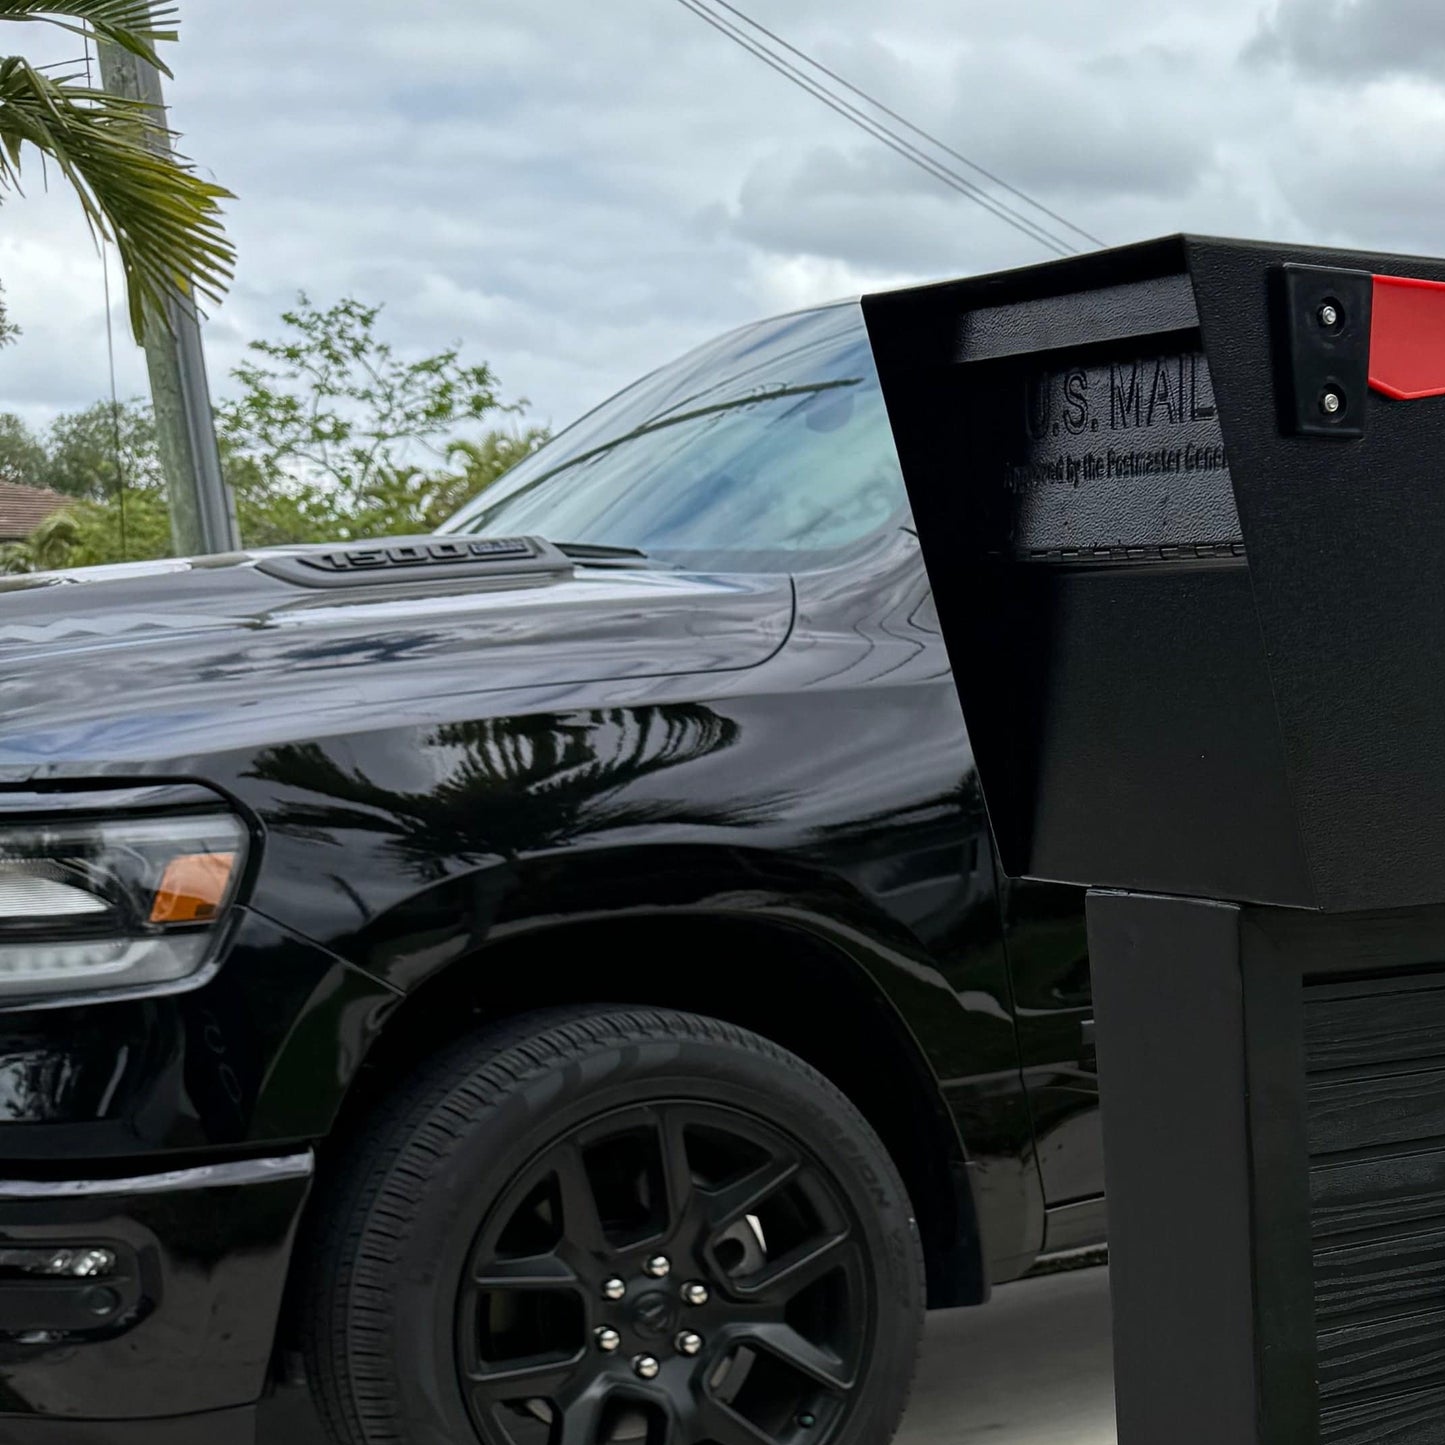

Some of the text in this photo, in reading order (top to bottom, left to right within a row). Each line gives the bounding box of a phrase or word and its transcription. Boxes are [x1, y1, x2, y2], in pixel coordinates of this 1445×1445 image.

[1026, 352, 1218, 440] U.S. MAIL
[1066, 453, 1081, 489] by
[1083, 451, 1104, 481] the
[1106, 446, 1182, 480] Postmaster
[322, 543, 468, 568] 1500
